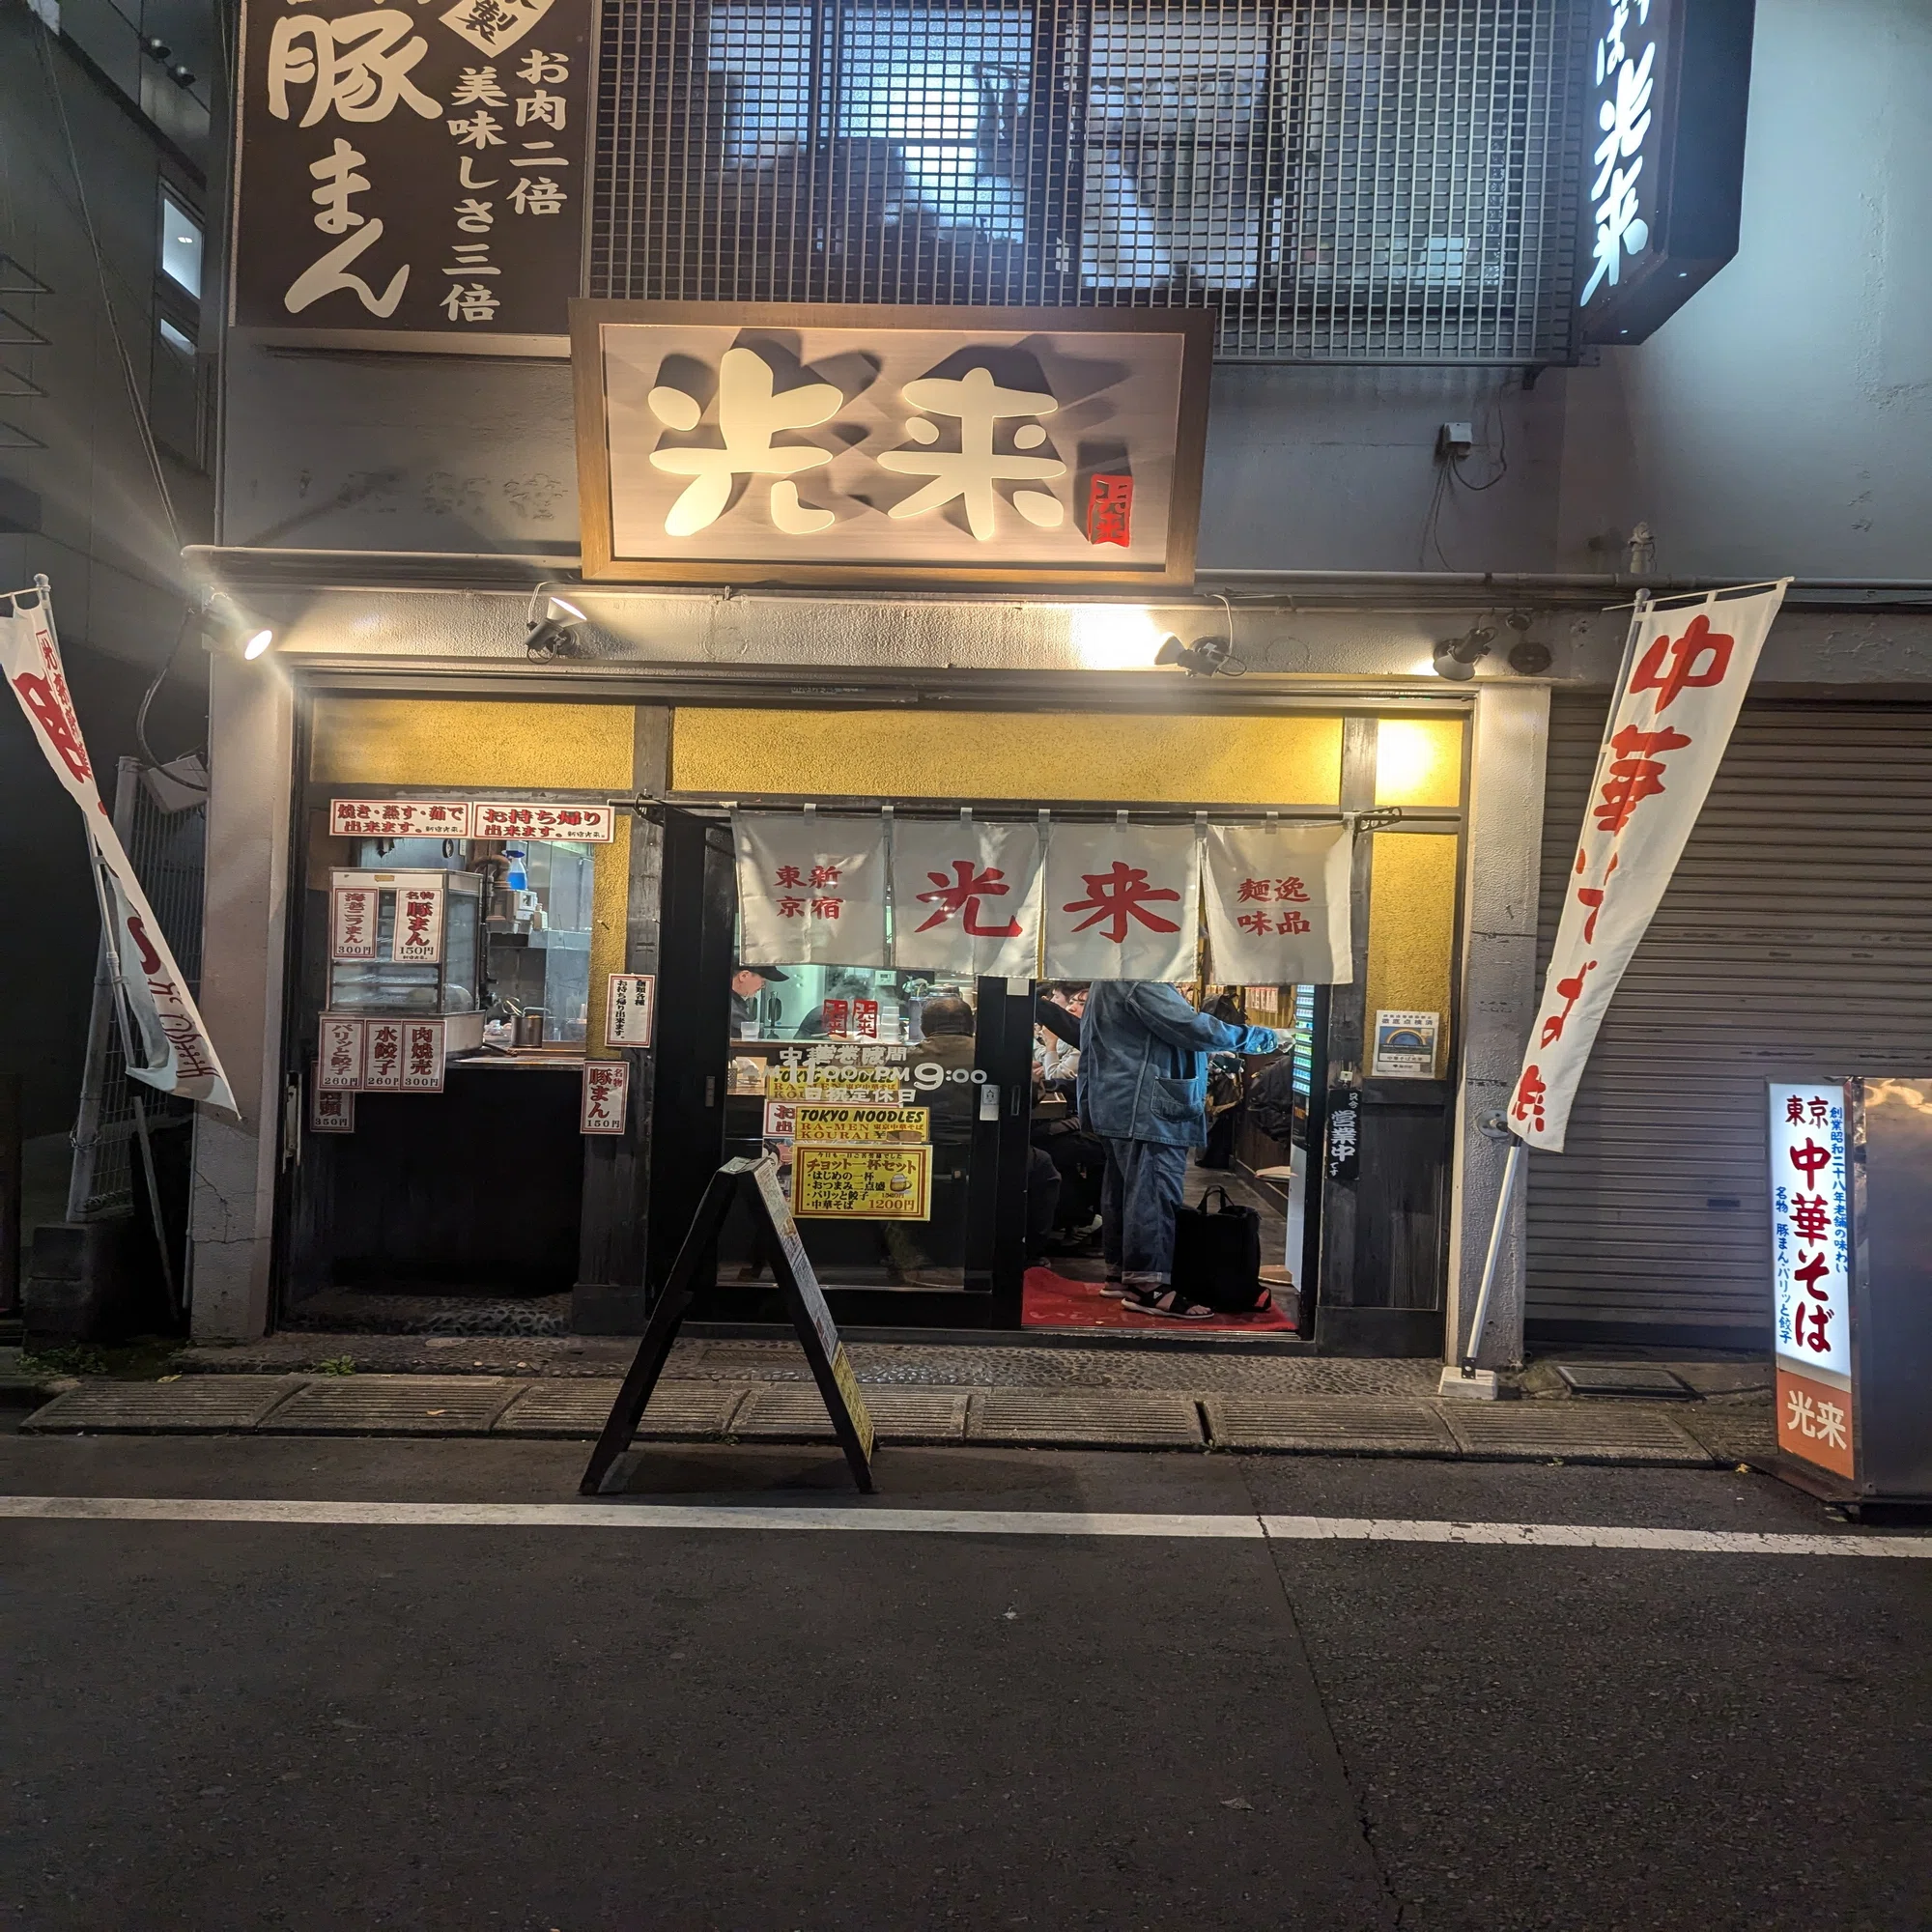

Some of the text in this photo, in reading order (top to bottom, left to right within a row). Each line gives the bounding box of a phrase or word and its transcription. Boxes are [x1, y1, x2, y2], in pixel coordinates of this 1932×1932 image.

[506, 49, 570, 215] お肉二倍
[268, 9, 443, 318] 豚まん
[440, 66, 509, 322] 美味しさ三倍
[648, 348, 1066, 541] 光来
[482, 808, 602, 826] お持ち帰り
[405, 891, 435, 900] 名物
[405, 901, 434, 946] 豚まん
[338, 947, 372, 955] 300円
[399, 947, 434, 955] 150円
[373, 1026, 399, 1076] 水餃子
[411, 1027, 434, 1076] 肉焼売
[405, 1078, 439, 1087] 300円
[612, 1068, 623, 1088] 名物
[588, 1068, 612, 1119] 豚まん
[315, 1118, 348, 1126] 350円
[801, 1109, 924, 1123] TOKYO NOODLES
[1785, 1094, 1829, 1129] 東京
[586, 1120, 620, 1128] 150円
[801, 1131, 869, 1140] KOURAI
[807, 1158, 917, 1175] チョット一杯セット
[868, 1199, 915, 1211] 1200円
[1776, 1186, 1788, 1213] 名物
[1789, 1137, 1835, 1353] 中華そば
[1787, 1389, 1847, 1450] 光来
